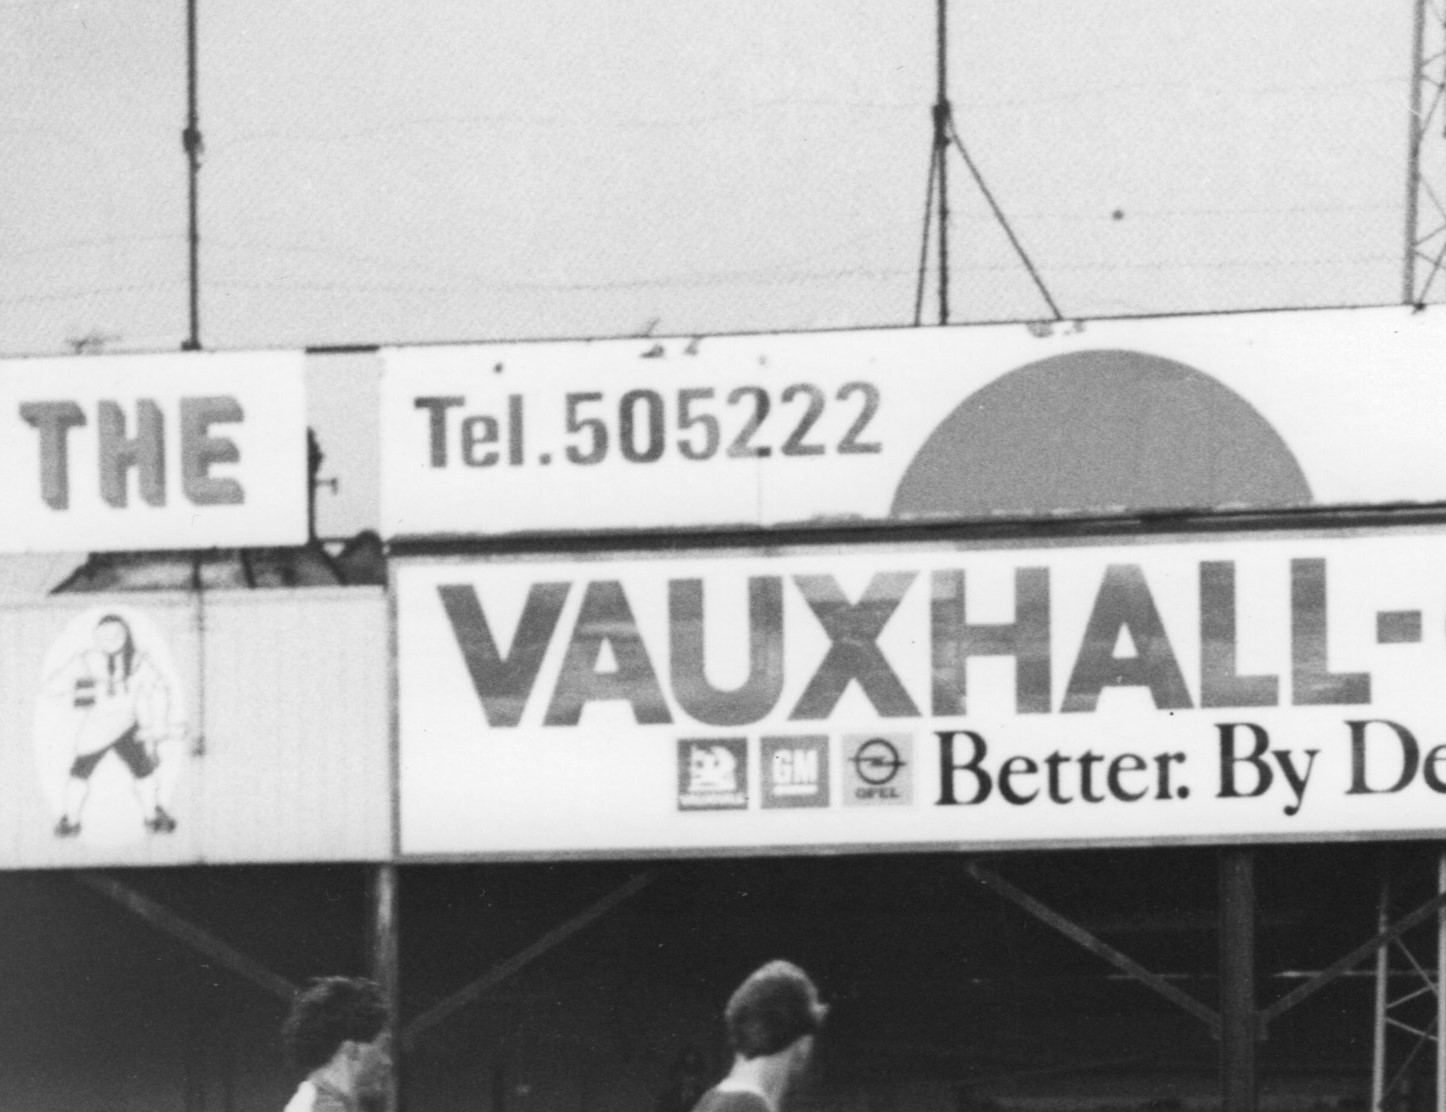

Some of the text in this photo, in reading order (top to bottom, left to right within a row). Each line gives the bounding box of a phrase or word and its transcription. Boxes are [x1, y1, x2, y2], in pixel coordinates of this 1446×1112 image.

[18, 396, 246, 511] THE
[773, 748, 818, 784] GM
[854, 786, 901, 800] OPEL
[934, 729, 1191, 806] Better.
[1215, 722, 1321, 816] By
